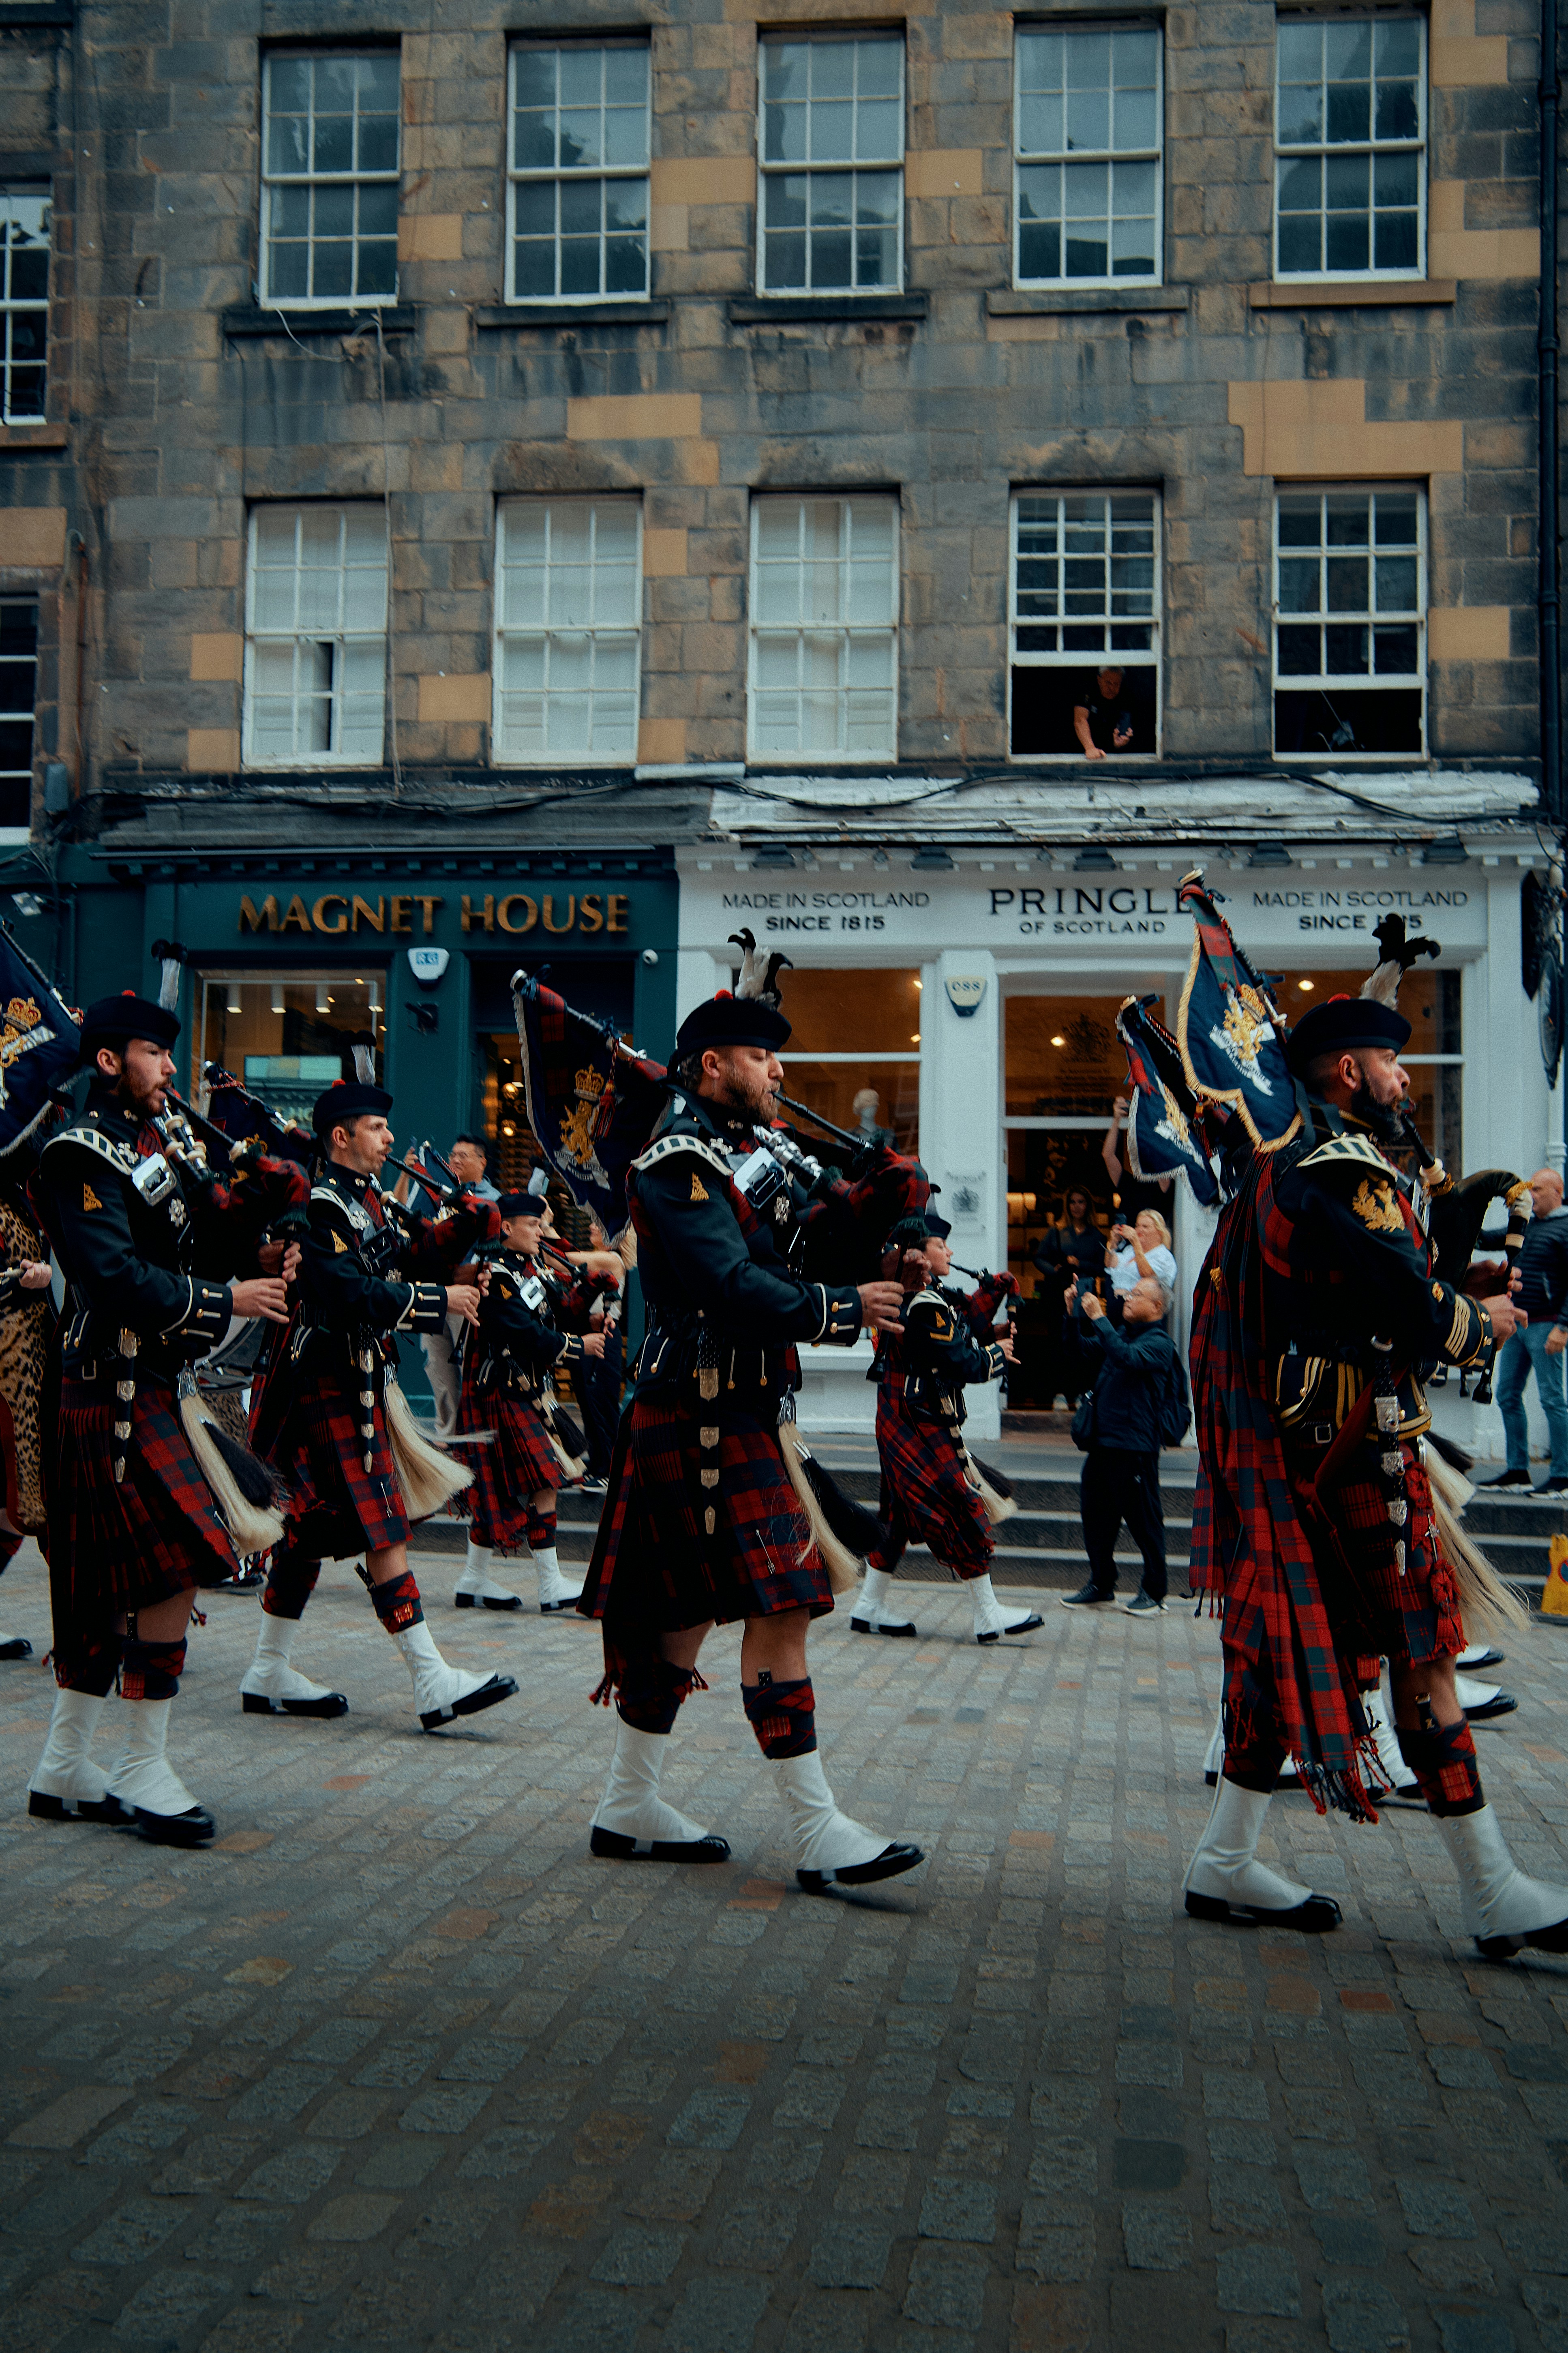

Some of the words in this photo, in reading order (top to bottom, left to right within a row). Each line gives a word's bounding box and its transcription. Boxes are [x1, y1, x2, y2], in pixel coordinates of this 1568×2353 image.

[722, 893, 782, 908] MADE
[786, 893, 806, 908] IN
[812, 893, 930, 908] SCOTLAND
[1253, 891, 1315, 907] MADE
[1320, 891, 1339, 906] IN
[1347, 891, 1468, 907] SCOTLAND
[237, 894, 443, 933] MAGNET
[461, 894, 629, 933] HOUSE
[765, 915, 831, 931] SINCE
[841, 915, 885, 930] 1815
[1019, 921, 1045, 933] OF
[1054, 920, 1166, 934] SCOTLAND
[1298, 915, 1367, 930] SINCE
